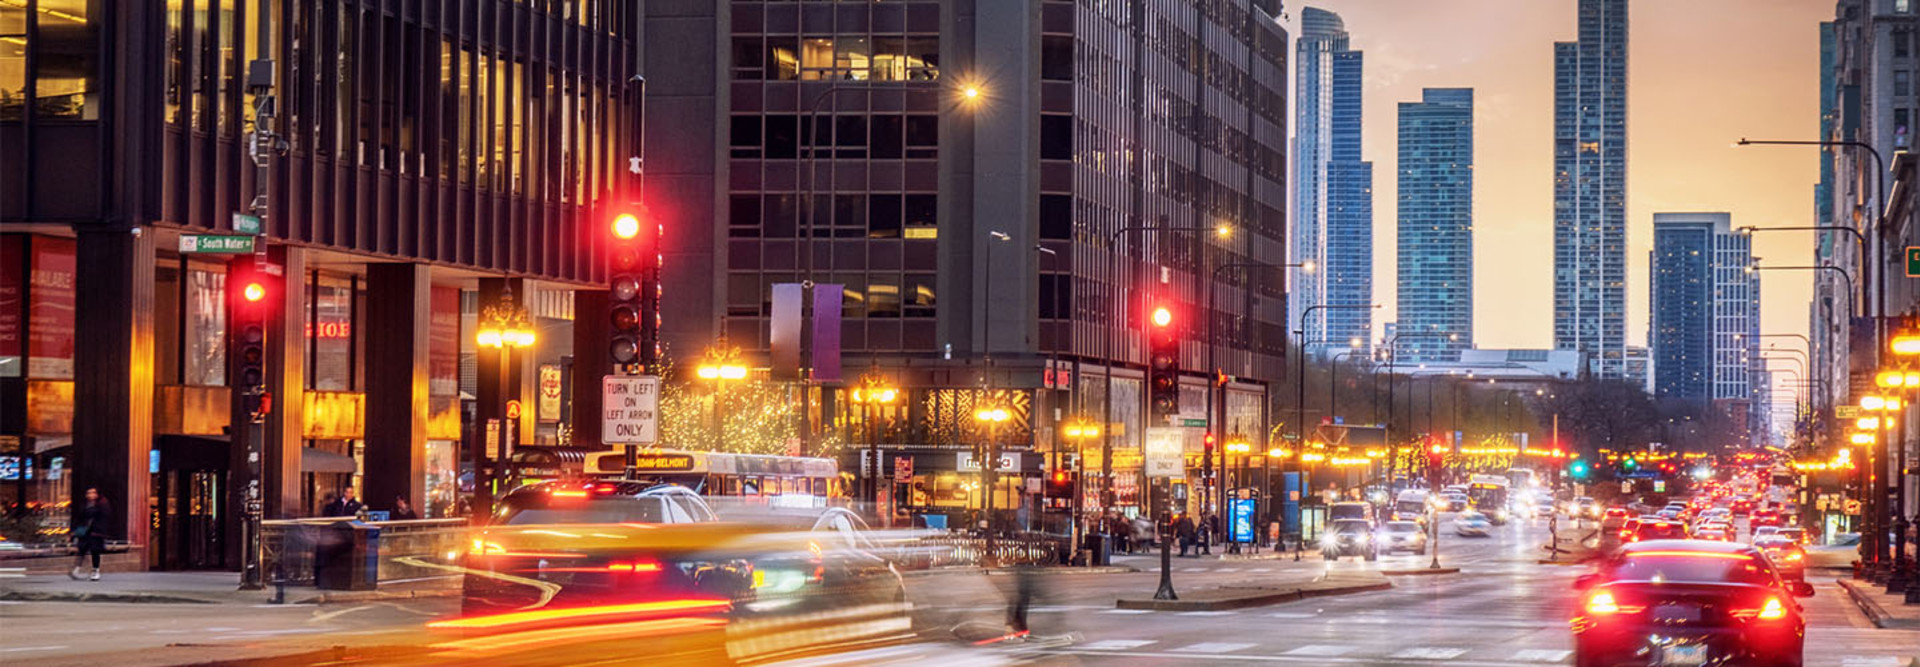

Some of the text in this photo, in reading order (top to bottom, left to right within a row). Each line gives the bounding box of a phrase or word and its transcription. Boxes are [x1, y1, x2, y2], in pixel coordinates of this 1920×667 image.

[202, 238, 223, 249] South
[224, 238, 244, 249] Water
[607, 383, 654, 395] TURN LEFT
[624, 397, 636, 407] ON
[606, 410, 653, 420] LEFT ARROW
[616, 423, 643, 437] ONLY
